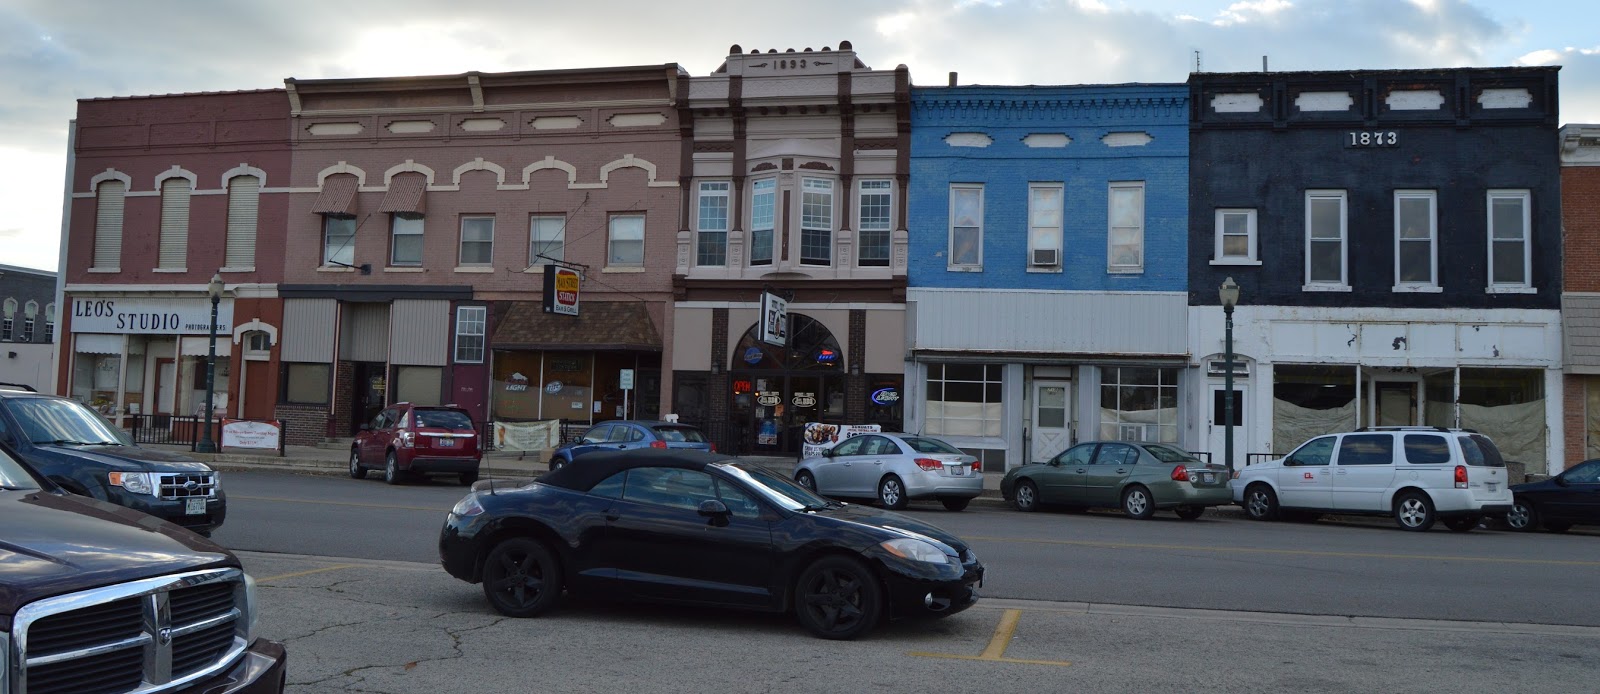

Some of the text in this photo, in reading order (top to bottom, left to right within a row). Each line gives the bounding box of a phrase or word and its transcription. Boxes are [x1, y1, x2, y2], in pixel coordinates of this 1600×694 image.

[773, 59, 807, 70] 1893
[1349, 131, 1397, 146] 1873
[75, 299, 115, 317] LEO'S
[116, 313, 180, 330] STUDIO
[185, 323, 226, 331] PHOTOGRAERS
[734, 381, 751, 392] OPEN
